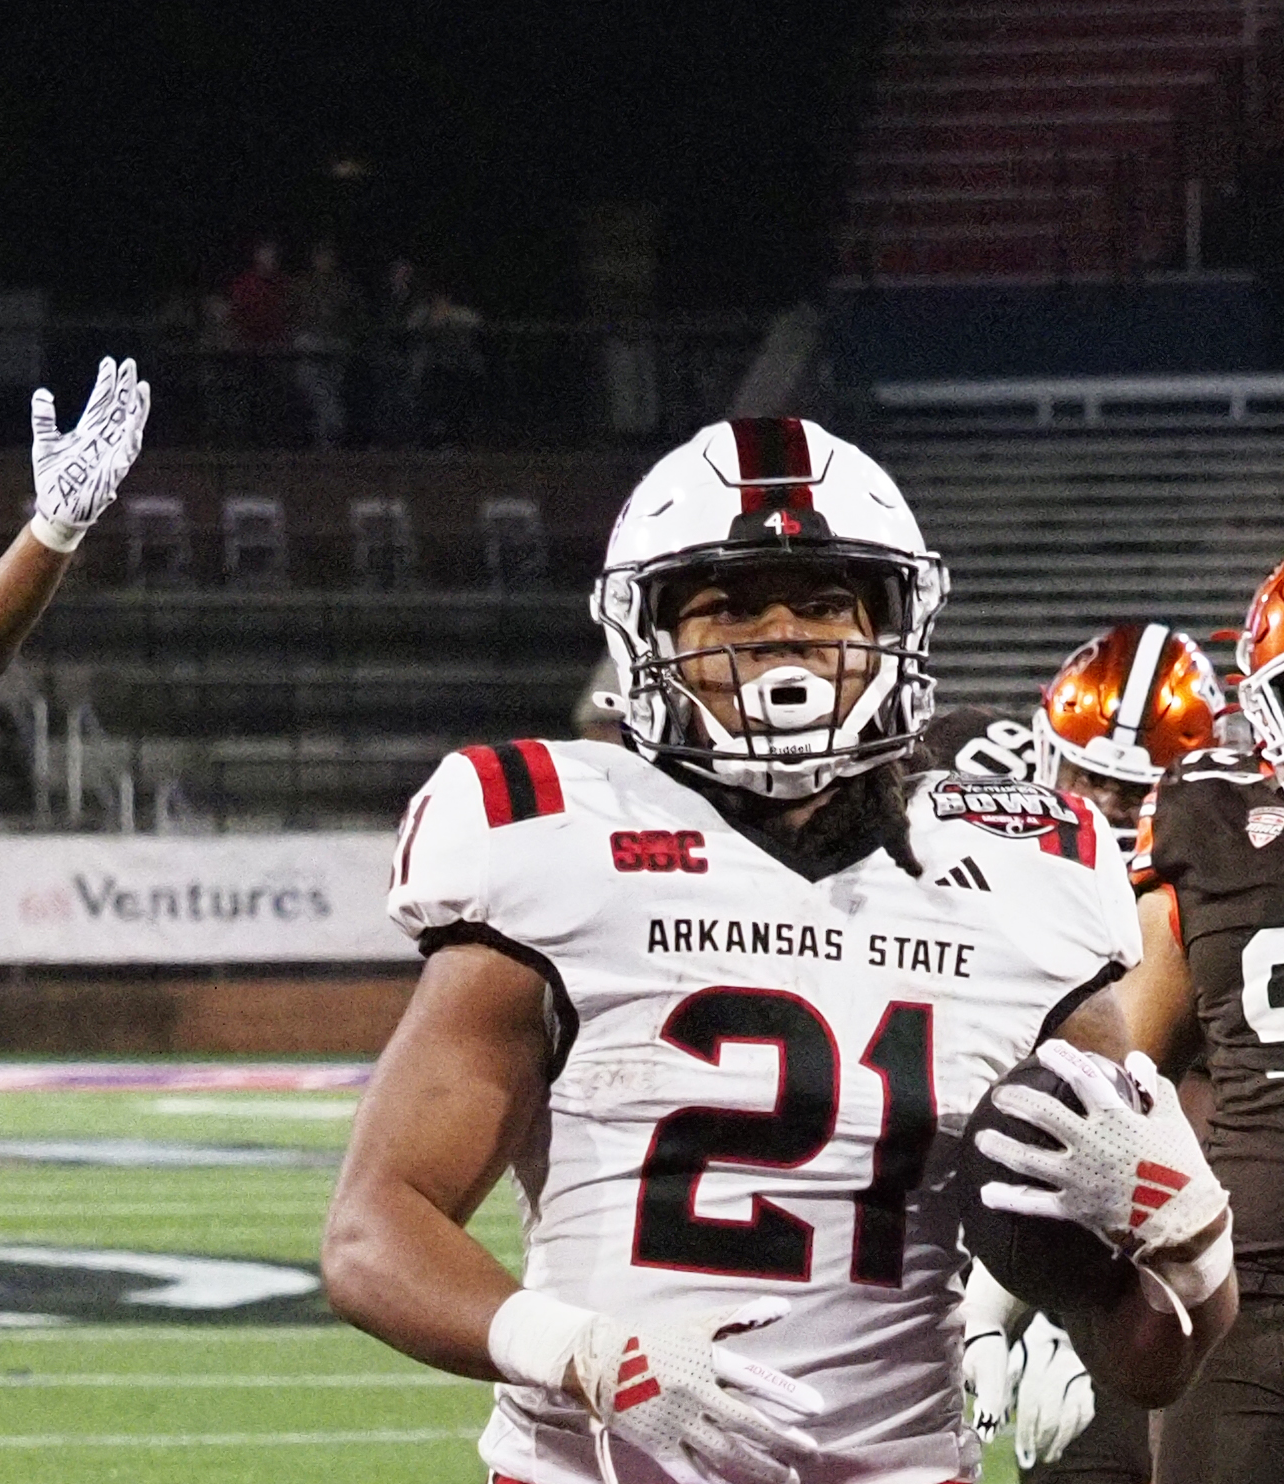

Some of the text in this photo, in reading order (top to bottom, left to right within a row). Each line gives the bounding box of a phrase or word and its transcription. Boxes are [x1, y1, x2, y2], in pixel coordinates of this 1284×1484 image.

[931, 792, 1079, 825] BOWL
[610, 830, 709, 875] SBC
[72, 873, 333, 923] Ventures
[647, 918, 976, 979] ARKANSAS STATE
[631, 984, 939, 1289] 21
